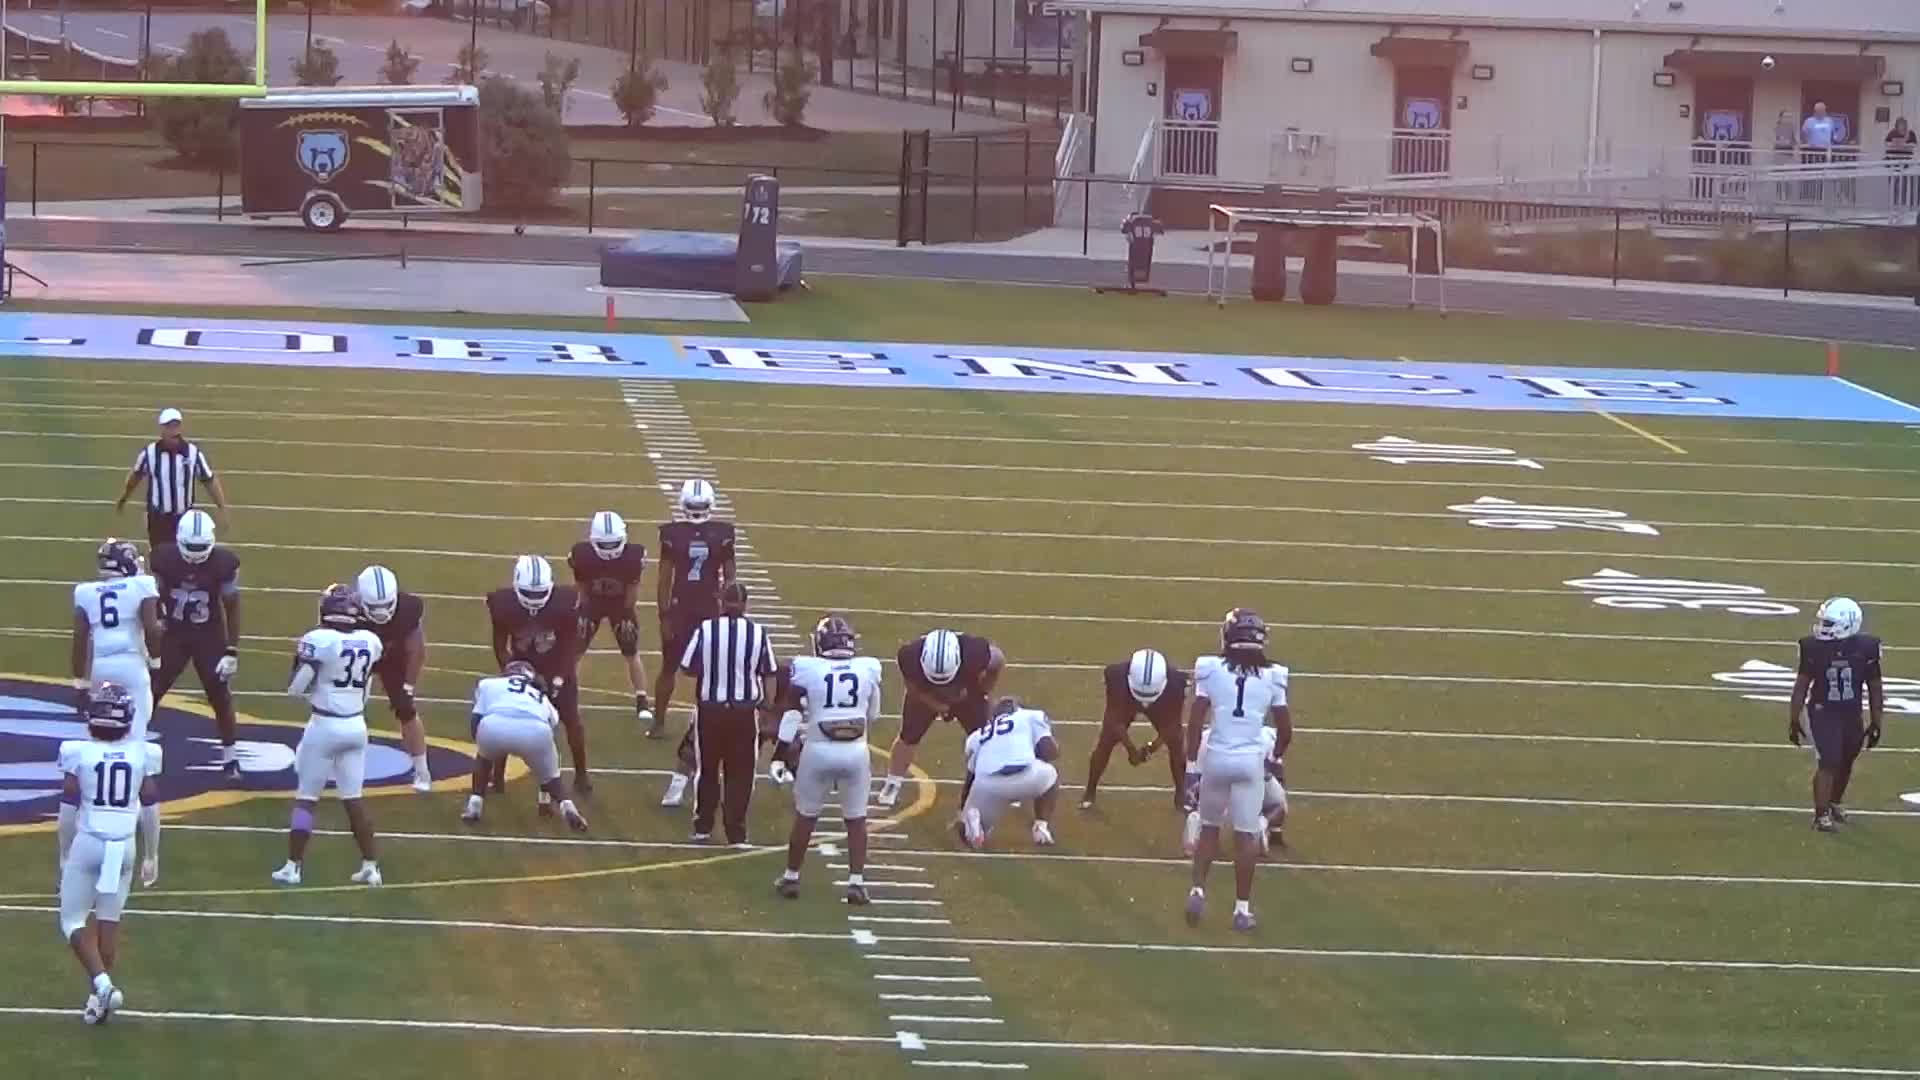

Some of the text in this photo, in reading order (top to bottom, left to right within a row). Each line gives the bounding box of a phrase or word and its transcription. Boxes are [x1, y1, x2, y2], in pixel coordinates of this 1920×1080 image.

[688, 547, 709, 581] 7
[100, 592, 119, 629] 6
[170, 589, 210, 623] 73
[333, 649, 370, 687] 33
[1823, 668, 1853, 702] 11
[822, 673, 858, 708] 13
[1230, 677, 1242, 717] 1
[93, 762, 132, 807] 10
